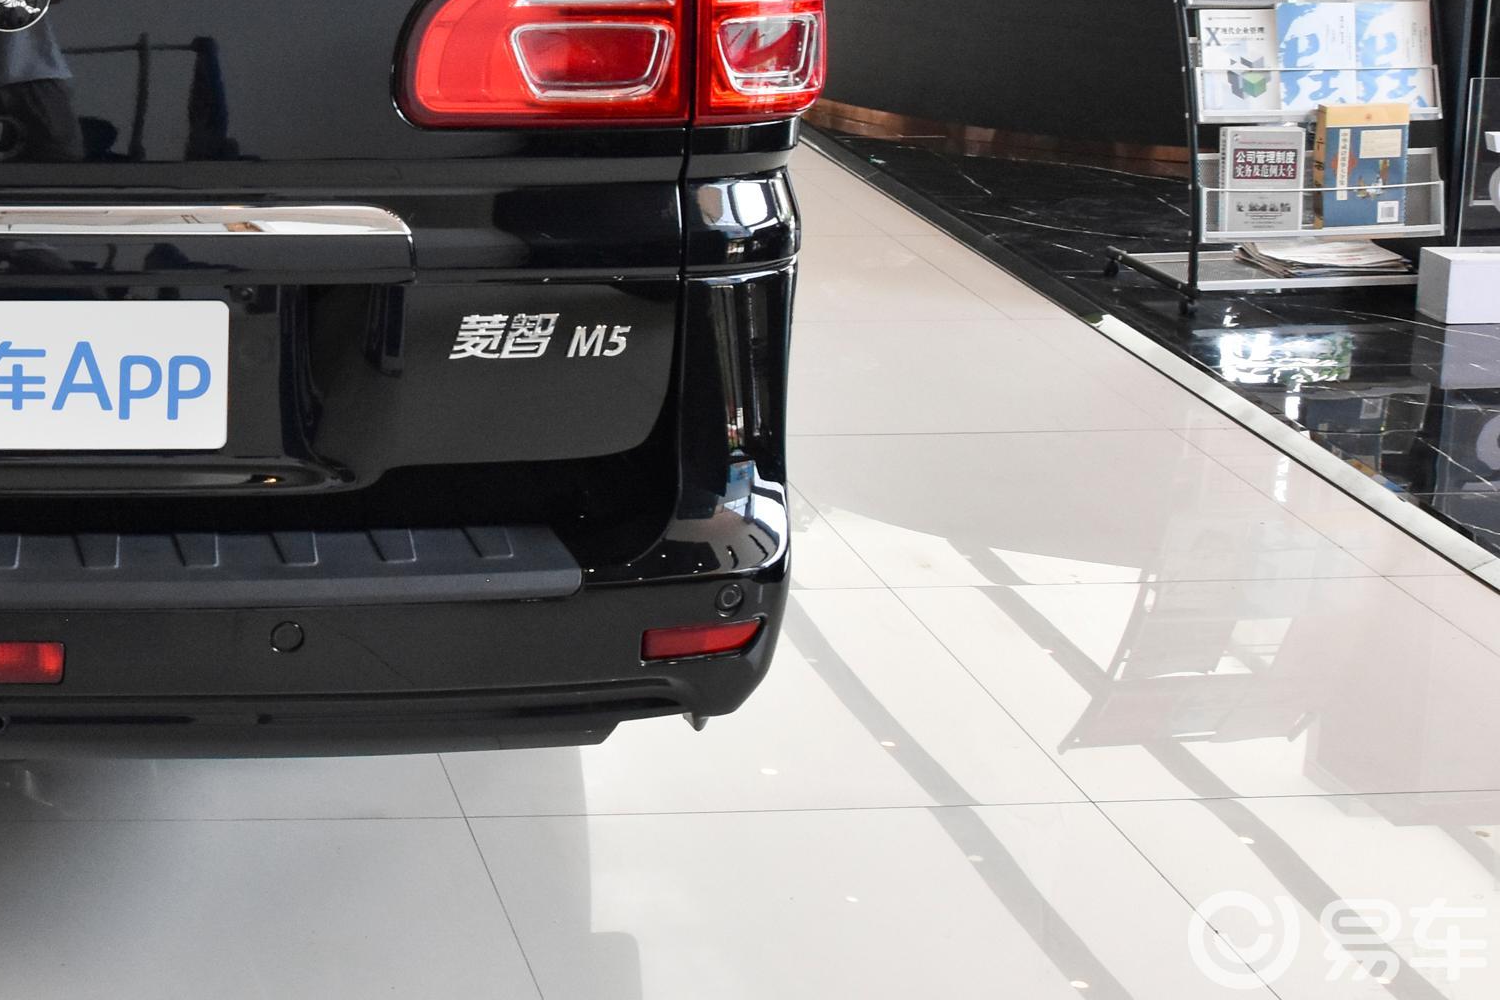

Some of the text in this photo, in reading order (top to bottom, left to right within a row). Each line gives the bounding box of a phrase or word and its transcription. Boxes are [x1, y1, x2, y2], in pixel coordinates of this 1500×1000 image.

[1235, 151, 1296, 164] 公司管理制度
[1235, 165, 1295, 178] 实务及范例大全
[448, 312, 632, 359] 菱智 M5
